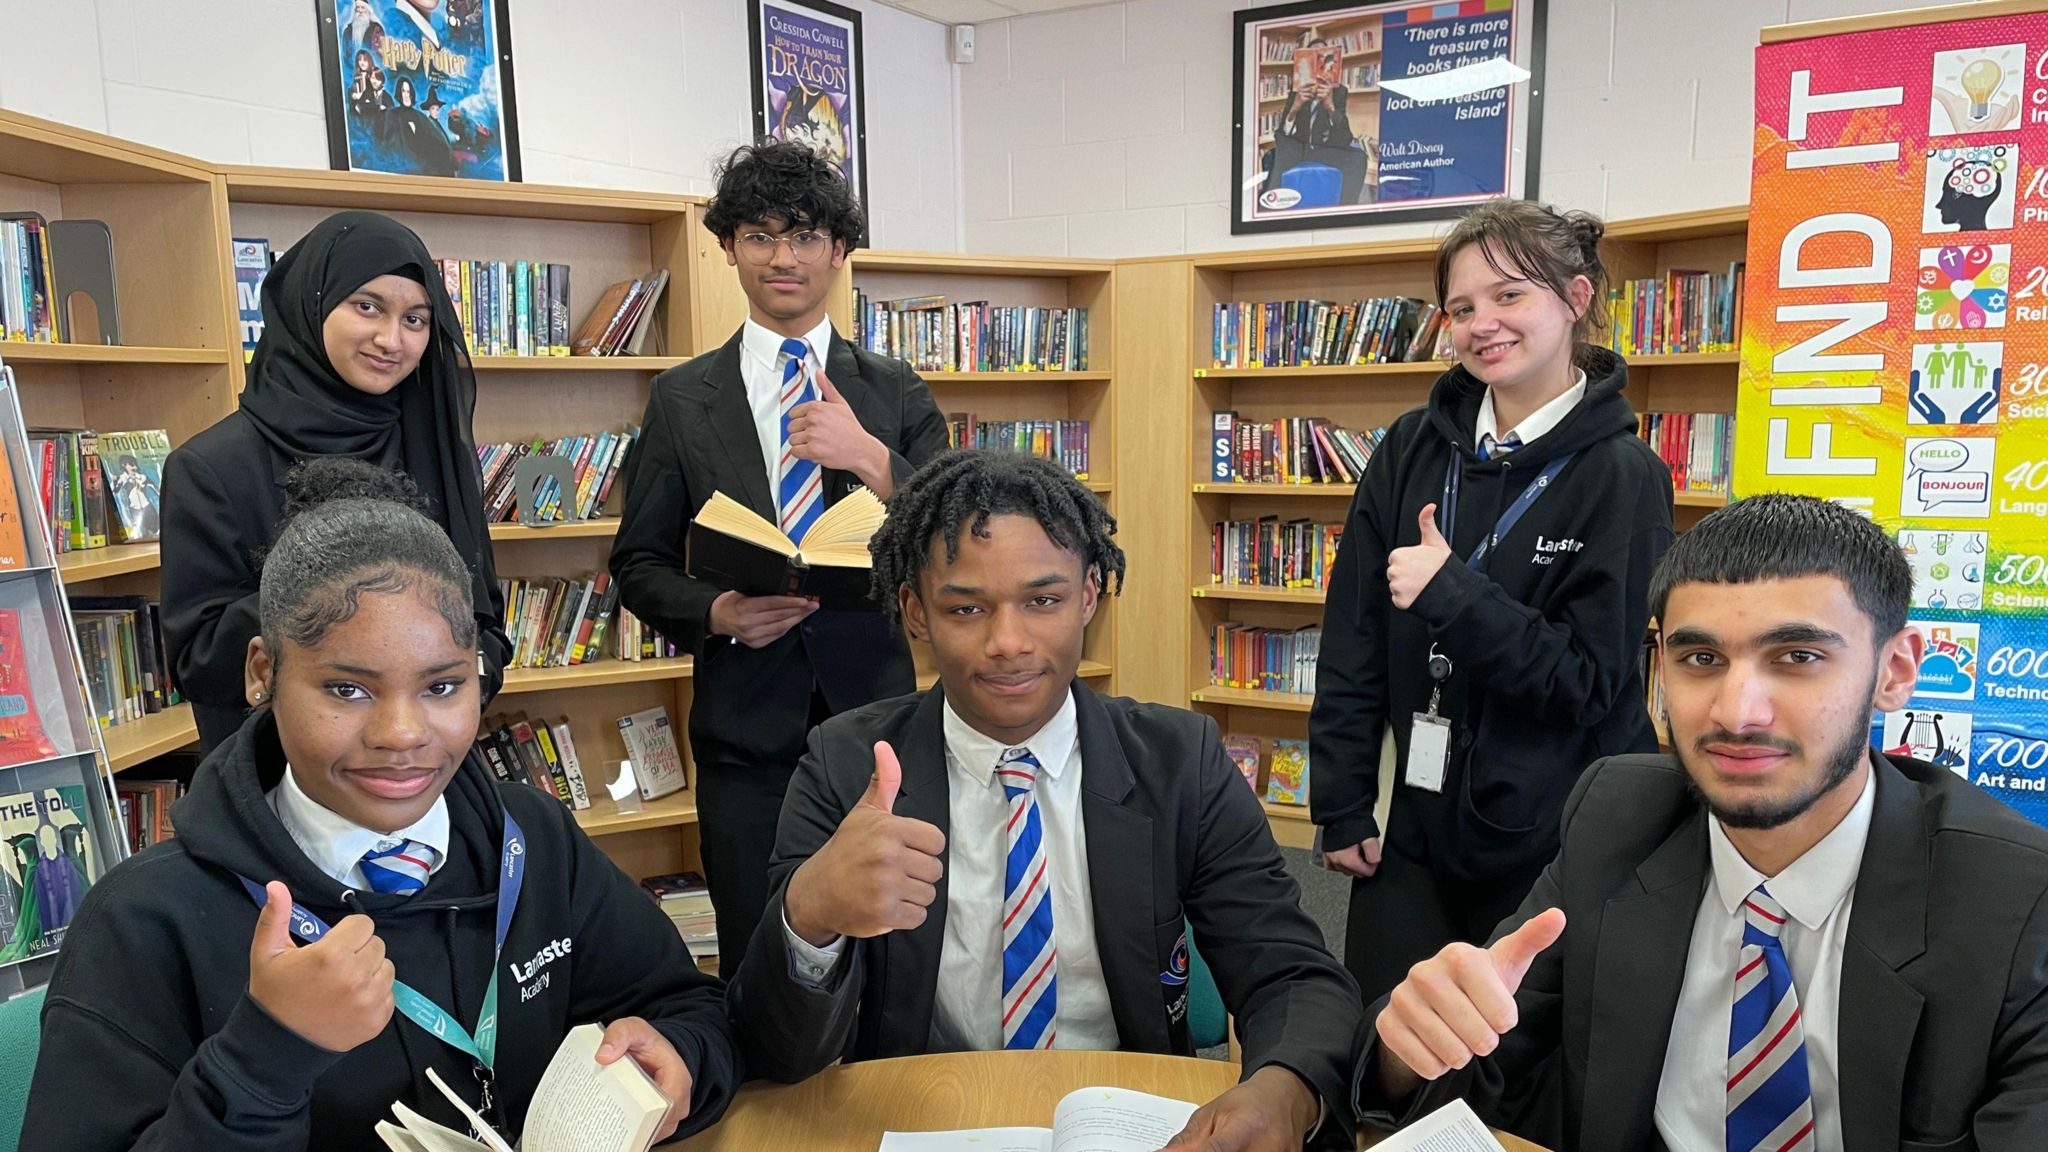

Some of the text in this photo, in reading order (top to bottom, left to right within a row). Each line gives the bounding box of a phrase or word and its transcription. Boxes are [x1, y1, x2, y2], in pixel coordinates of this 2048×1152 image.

[769, 15, 845, 50] CRESSIDA COWELL
[1452, 22, 1466, 37] is
[1469, 18, 1509, 34] more
[774, 35, 791, 49] HOW
[801, 43, 823, 59] TRAIN
[823, 49, 843, 64] YOUR
[1428, 34, 1507, 56] treasure in
[379, 35, 467, 78] Harry Potter
[768, 44, 848, 95] DRAGON
[1406, 59, 1451, 75] books
[1379, 140, 1444, 157] Walt Disney
[1379, 156, 1455, 172] American Author
[1766, 69, 1905, 476] FIND IT
[102, 434, 164, 452] TROUBLE
[1215, 438, 1230, 457] S
[1919, 449, 1961, 458] HELLO
[1922, 481, 1985, 490] BONJOUR
[1976, 738, 2048, 769] 700
[554, 776, 572, 801] RIOT
[1975, 772, 2046, 792] Art and
[0, 794, 83, 822] THE TOLL
[29, 936, 51, 952] NEAL
